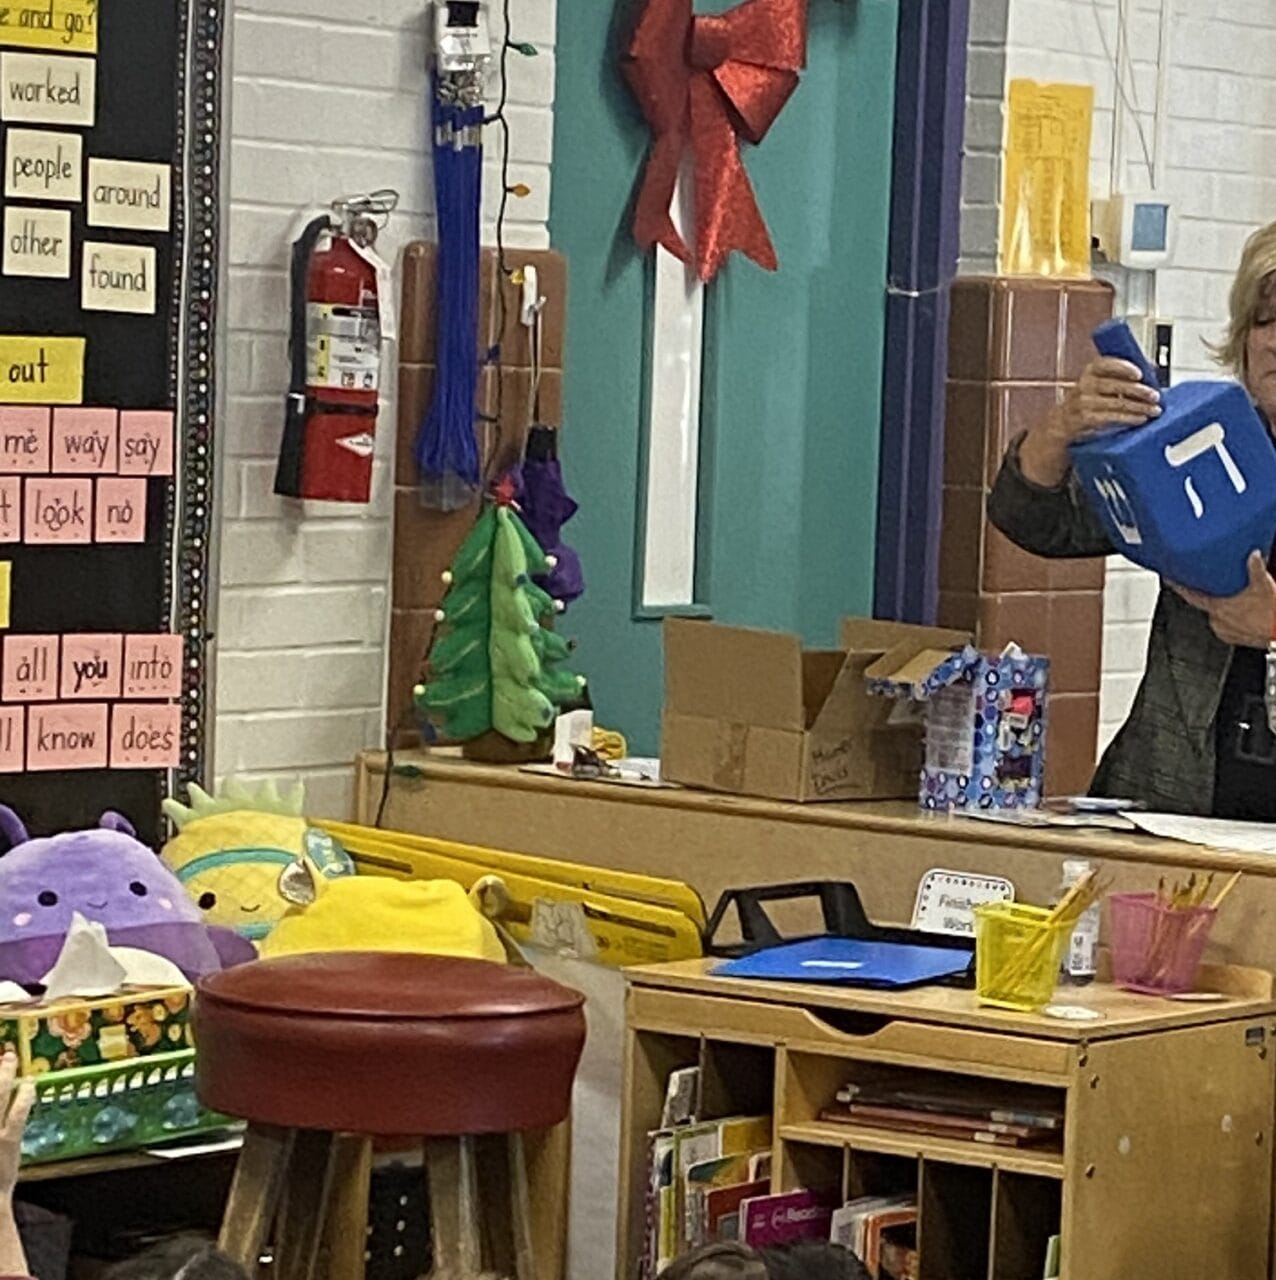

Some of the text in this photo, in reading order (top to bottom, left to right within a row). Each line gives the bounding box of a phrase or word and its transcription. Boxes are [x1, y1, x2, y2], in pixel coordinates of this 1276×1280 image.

[20, 0, 54, 28] and
[10, 69, 80, 105] worked
[12, 145, 72, 188] people
[94, 175, 160, 208] around
[11, 219, 62, 256] other
[89, 254, 147, 293] found
[8, 349, 49, 383] out
[64, 434, 109, 468] way
[125, 436, 160, 471] say
[1164, 421, 1247, 519] ה
[34, 489, 85, 526] look
[107, 502, 132, 523] no
[16, 645, 172, 694] all you into
[37, 716, 95, 750] know
[122, 716, 173, 751] does
